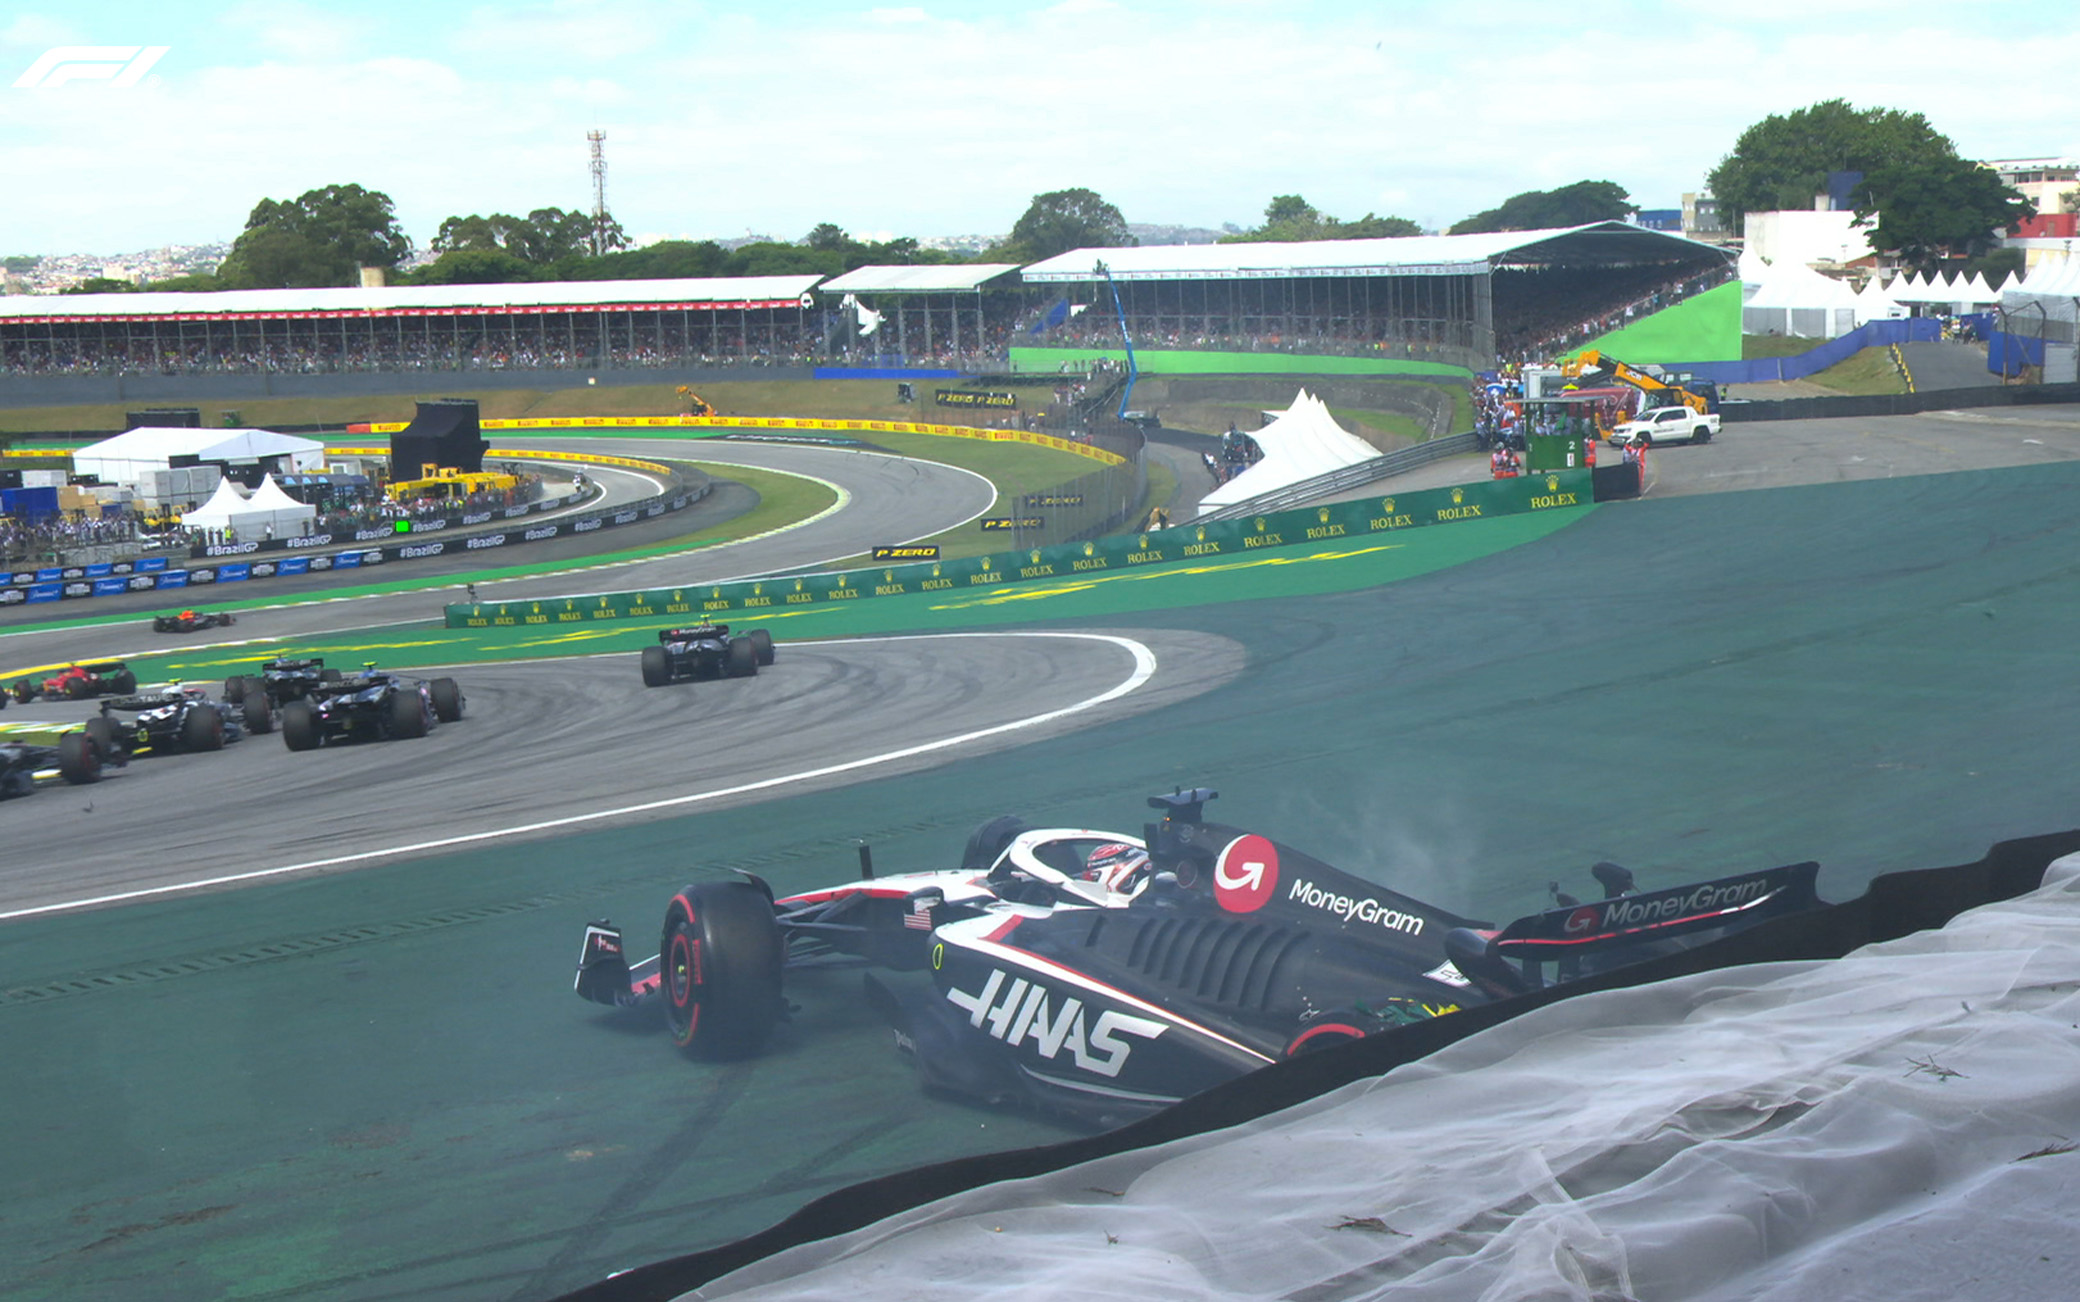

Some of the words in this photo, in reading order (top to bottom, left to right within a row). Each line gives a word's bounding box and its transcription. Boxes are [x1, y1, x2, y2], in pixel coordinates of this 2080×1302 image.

[1569, 441, 1575, 450] 2
[207, 542, 258, 556] #BrazilGP
[287, 535, 331, 547] #BrazilGP
[401, 544, 443, 557] #BrazilGP
[526, 615, 548, 623] ROLEX
[559, 613, 581, 621] ROLEX
[594, 609, 615, 618] ROLEX
[630, 606, 653, 615] ROLEX
[667, 604, 689, 613] ROLEX
[704, 600, 729, 610] ROLEX
[745, 597, 770, 607] ROLEX
[787, 593, 812, 603] ROLEX
[829, 589, 857, 599] ROLEX
[876, 584, 903, 595] ROLEX
[922, 578, 952, 590] ROLEX
[971, 572, 1002, 584] ROLEX
[1021, 565, 1053, 577] ROLEX
[1073, 558, 1107, 570] ROLEX
[1128, 551, 1162, 564] ROLEX
[1184, 542, 1220, 556] ROLEX
[1244, 534, 1282, 548] ROLEX
[1307, 524, 1345, 539] ROLEX
[1370, 514, 1413, 530] ROLEX
[1437, 505, 1482, 520] ROLEX
[1531, 493, 1576, 509] ROLEX
[876, 548, 889, 557] P
[891, 547, 937, 557] ZERO
[1288, 878, 1424, 936] MoneyGram
[1602, 878, 1767, 928] MoneyGram
[946, 968, 1170, 1078] HAAS
